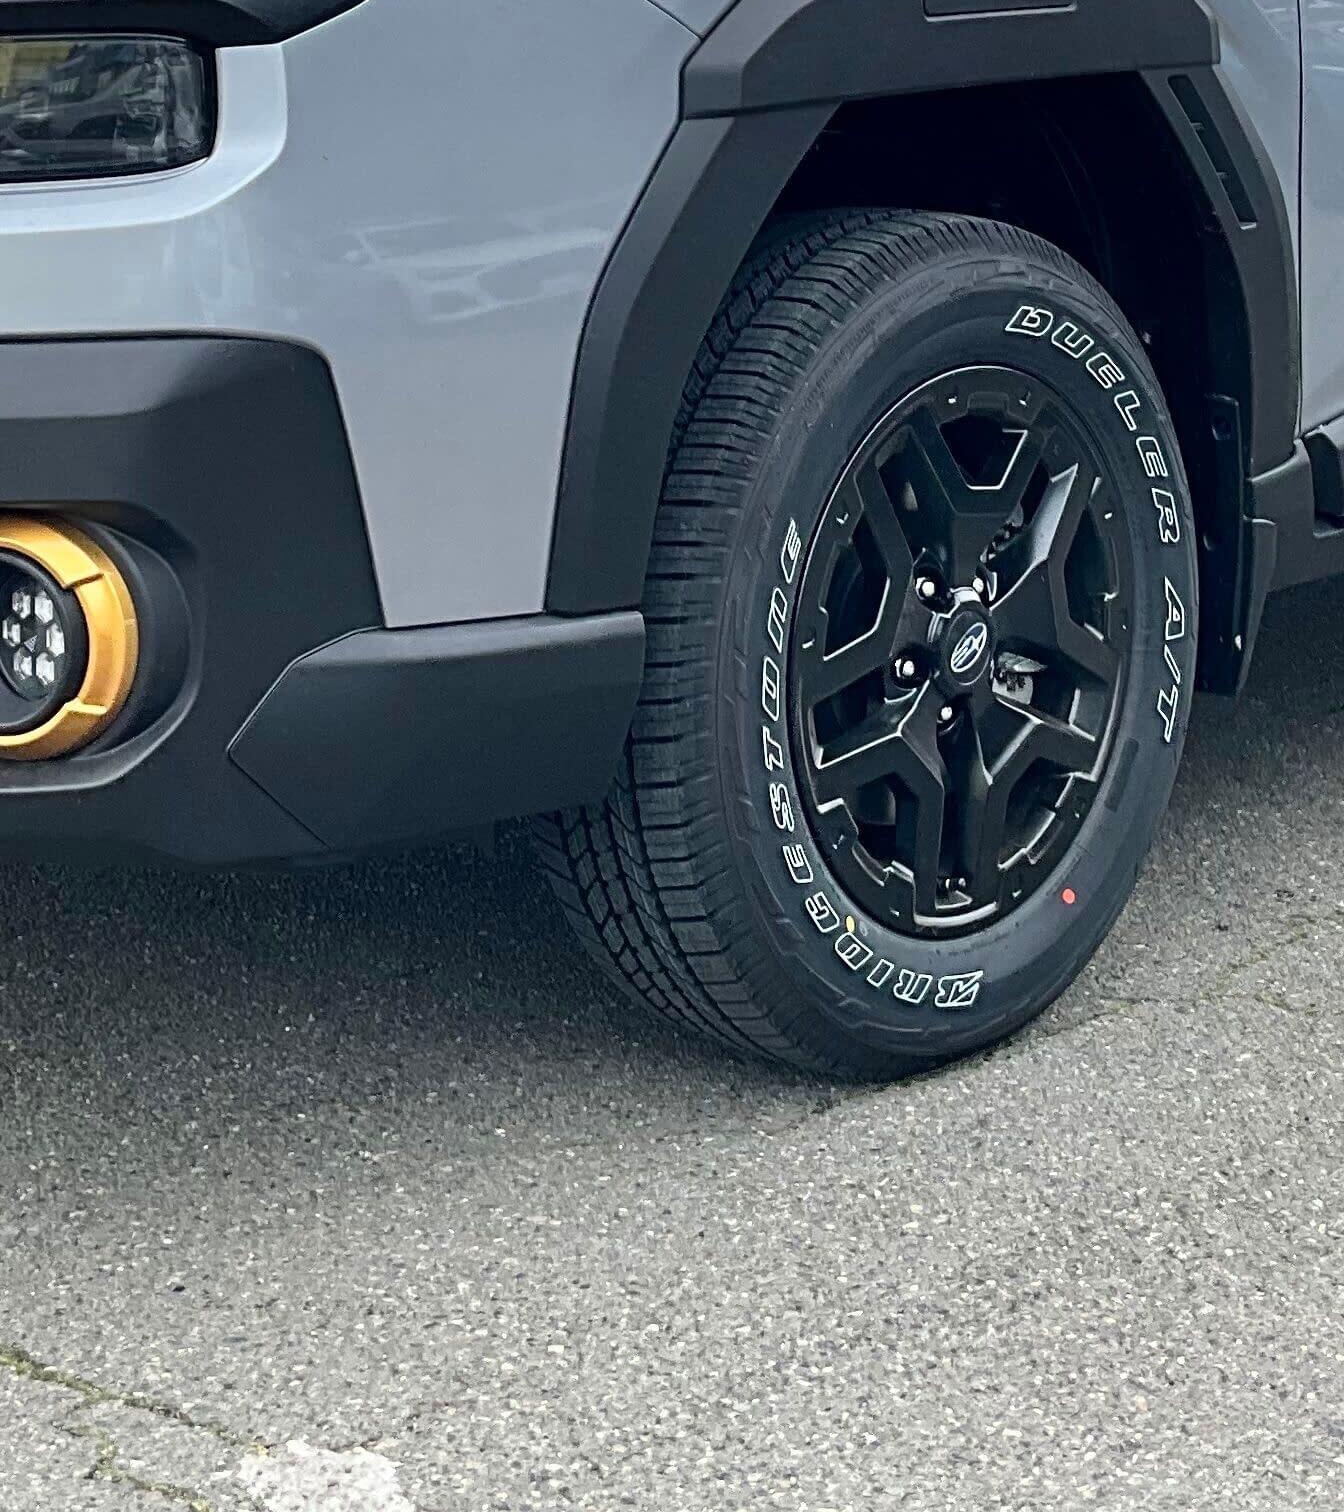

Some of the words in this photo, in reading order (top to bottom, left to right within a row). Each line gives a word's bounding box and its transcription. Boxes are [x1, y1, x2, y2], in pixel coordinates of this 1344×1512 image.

[1004, 304, 1182, 544] DUELER
[1158, 577, 1185, 744] A/T
[760, 518, 985, 1009] BRIDGESTONE
